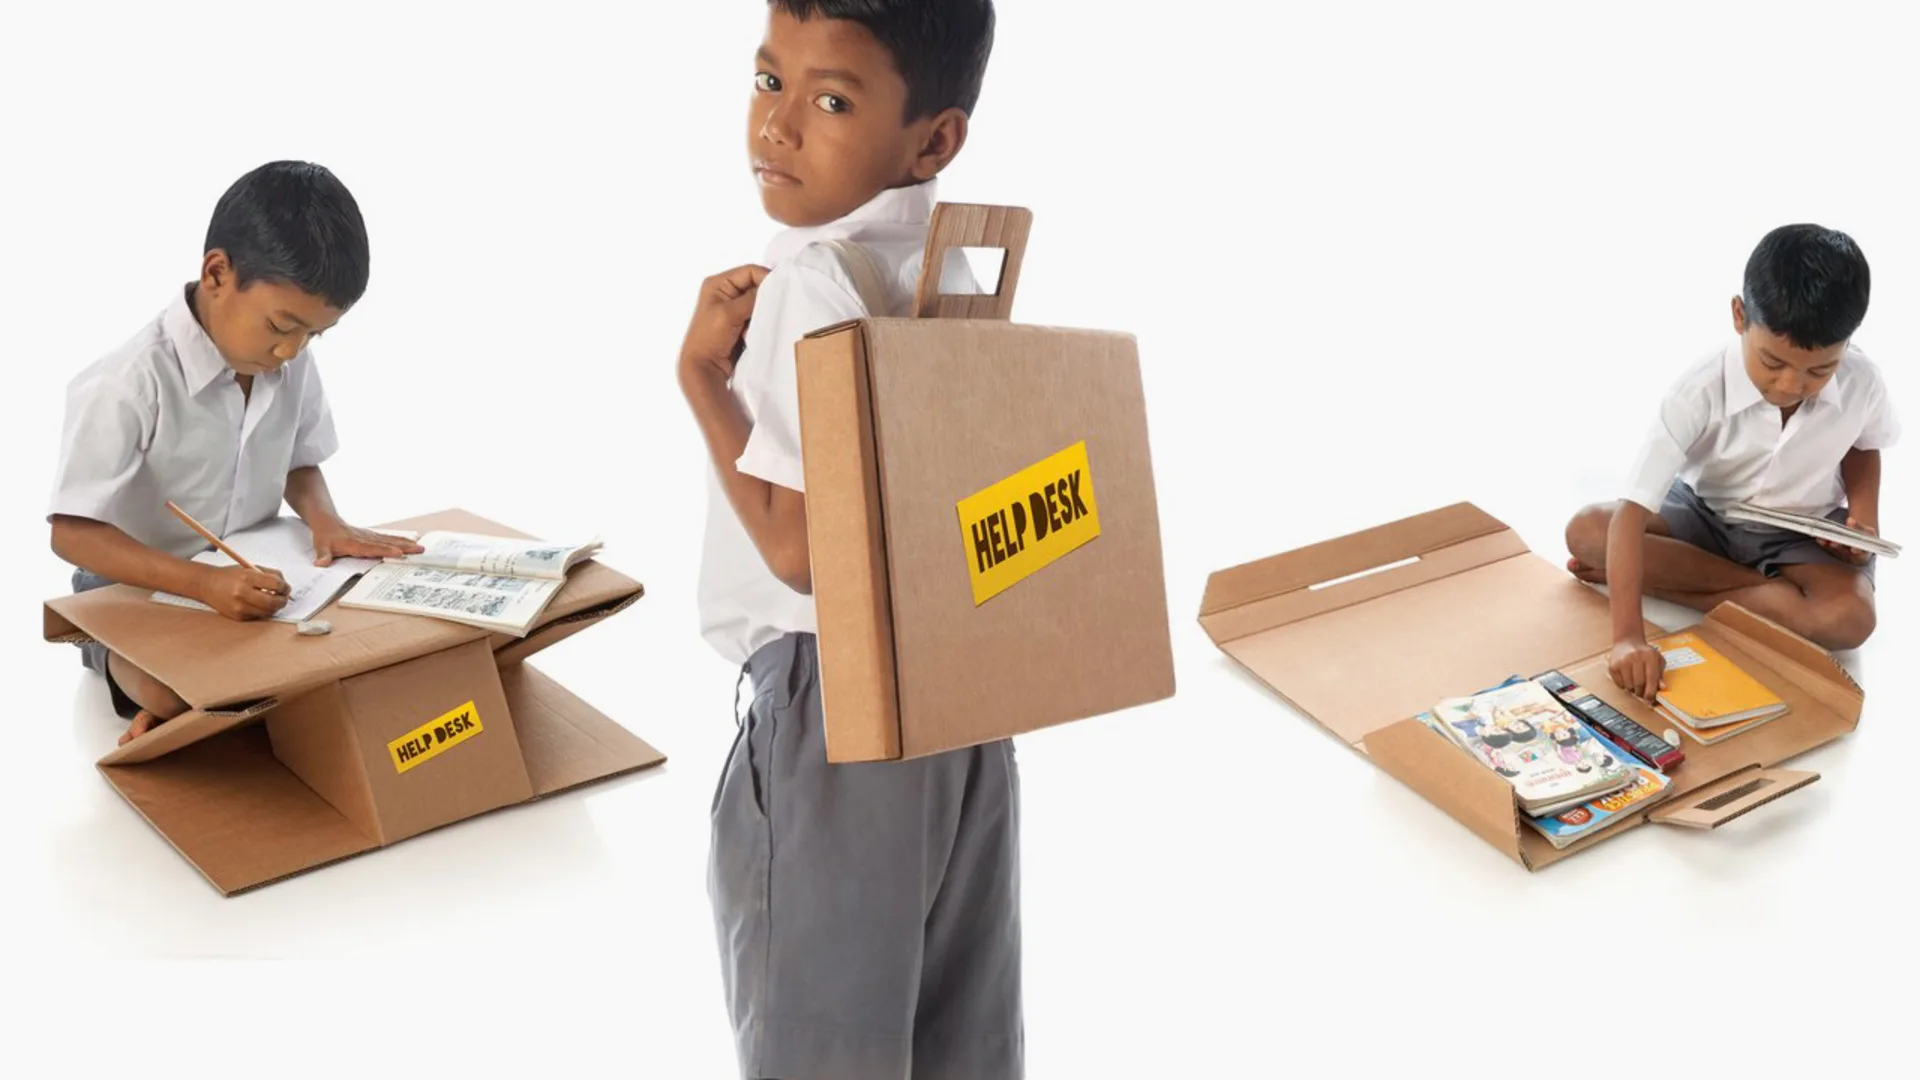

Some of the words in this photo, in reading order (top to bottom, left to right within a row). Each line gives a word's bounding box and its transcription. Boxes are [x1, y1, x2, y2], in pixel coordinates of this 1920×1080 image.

[971, 501, 1027, 574] HELP
[1028, 469, 1088, 542] DESK
[396, 733, 432, 763] HELP
[433, 711, 475, 744] DESK
